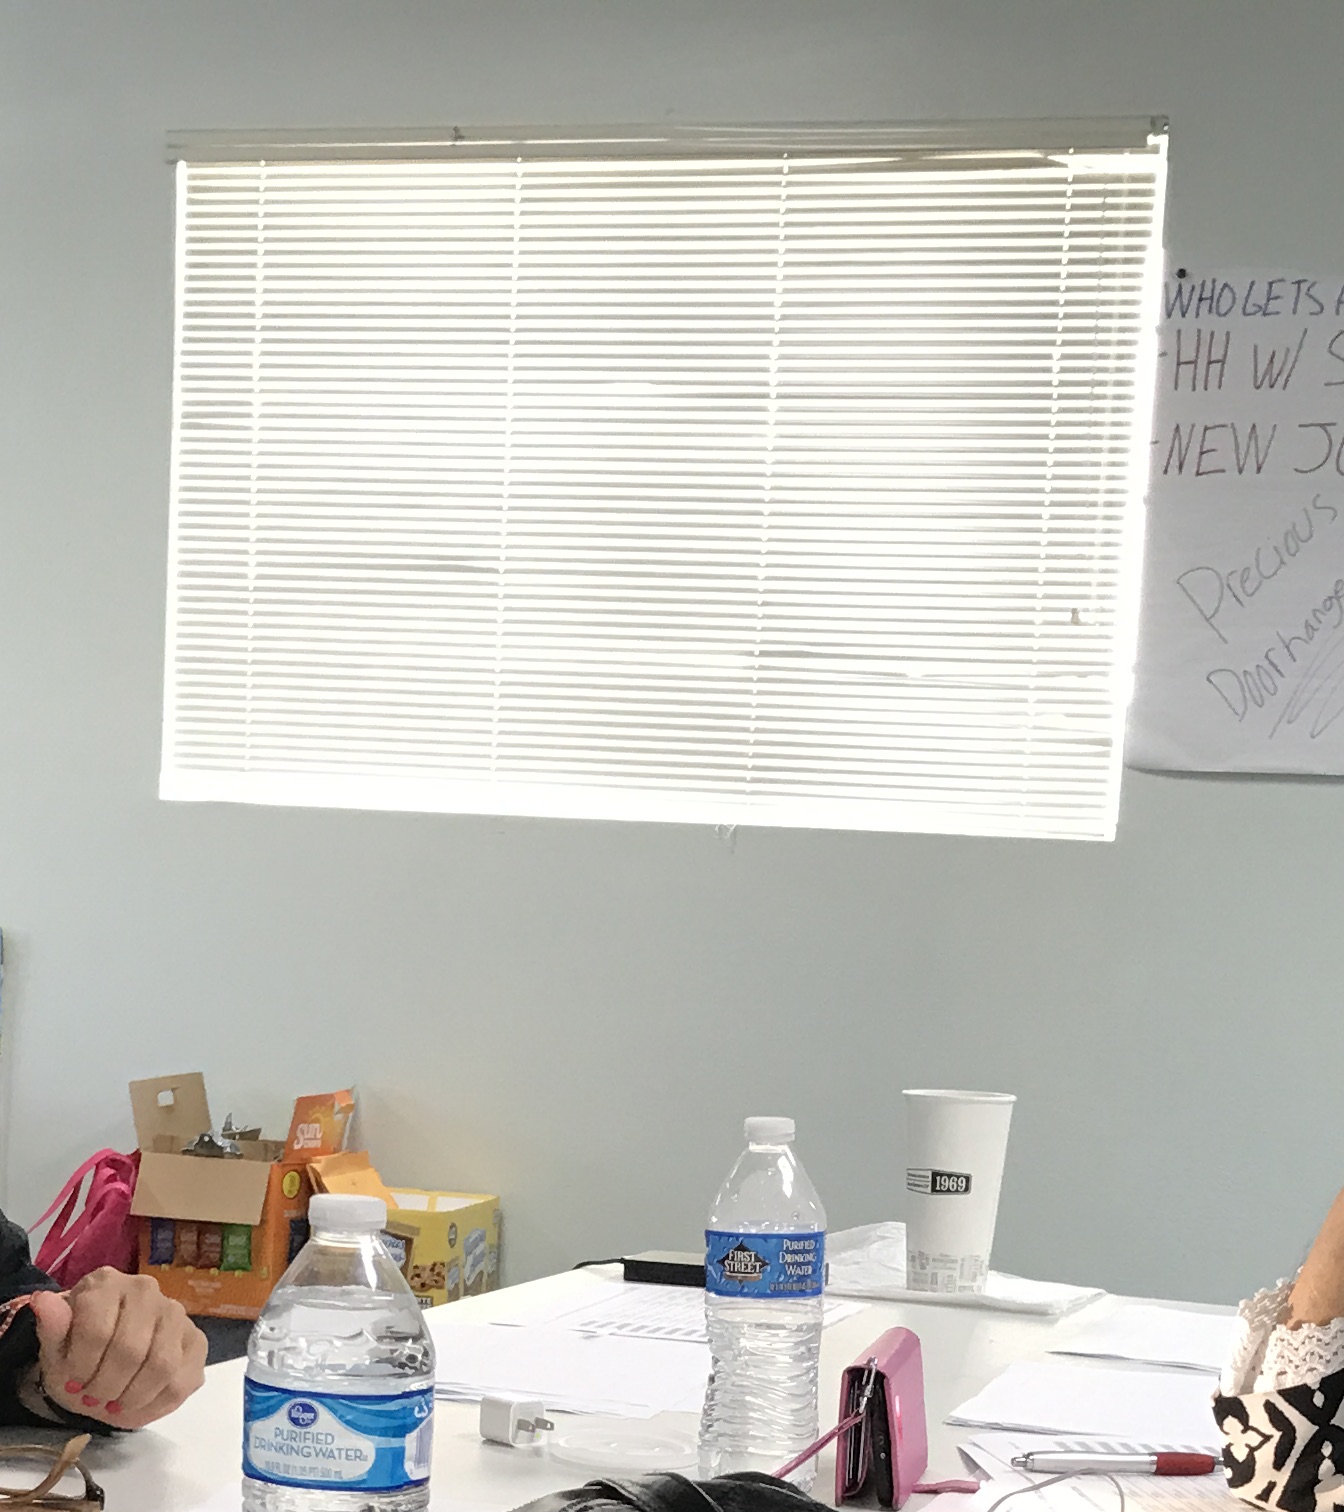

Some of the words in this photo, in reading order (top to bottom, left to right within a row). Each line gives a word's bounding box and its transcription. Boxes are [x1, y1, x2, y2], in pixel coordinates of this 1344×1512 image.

[1164, 279, 1237, 318] WHO
[1240, 278, 1324, 317] GETS
[1176, 493, 1338, 644] Precious
[935, 1176, 966, 1192] 1969
[728, 1251, 757, 1262] FIRST
[724, 1261, 762, 1273] STREET
[274, 1427, 335, 1446] PURIFIED
[254, 1436, 311, 1458] DRINKING
[313, 1446, 363, 1462] WATER
